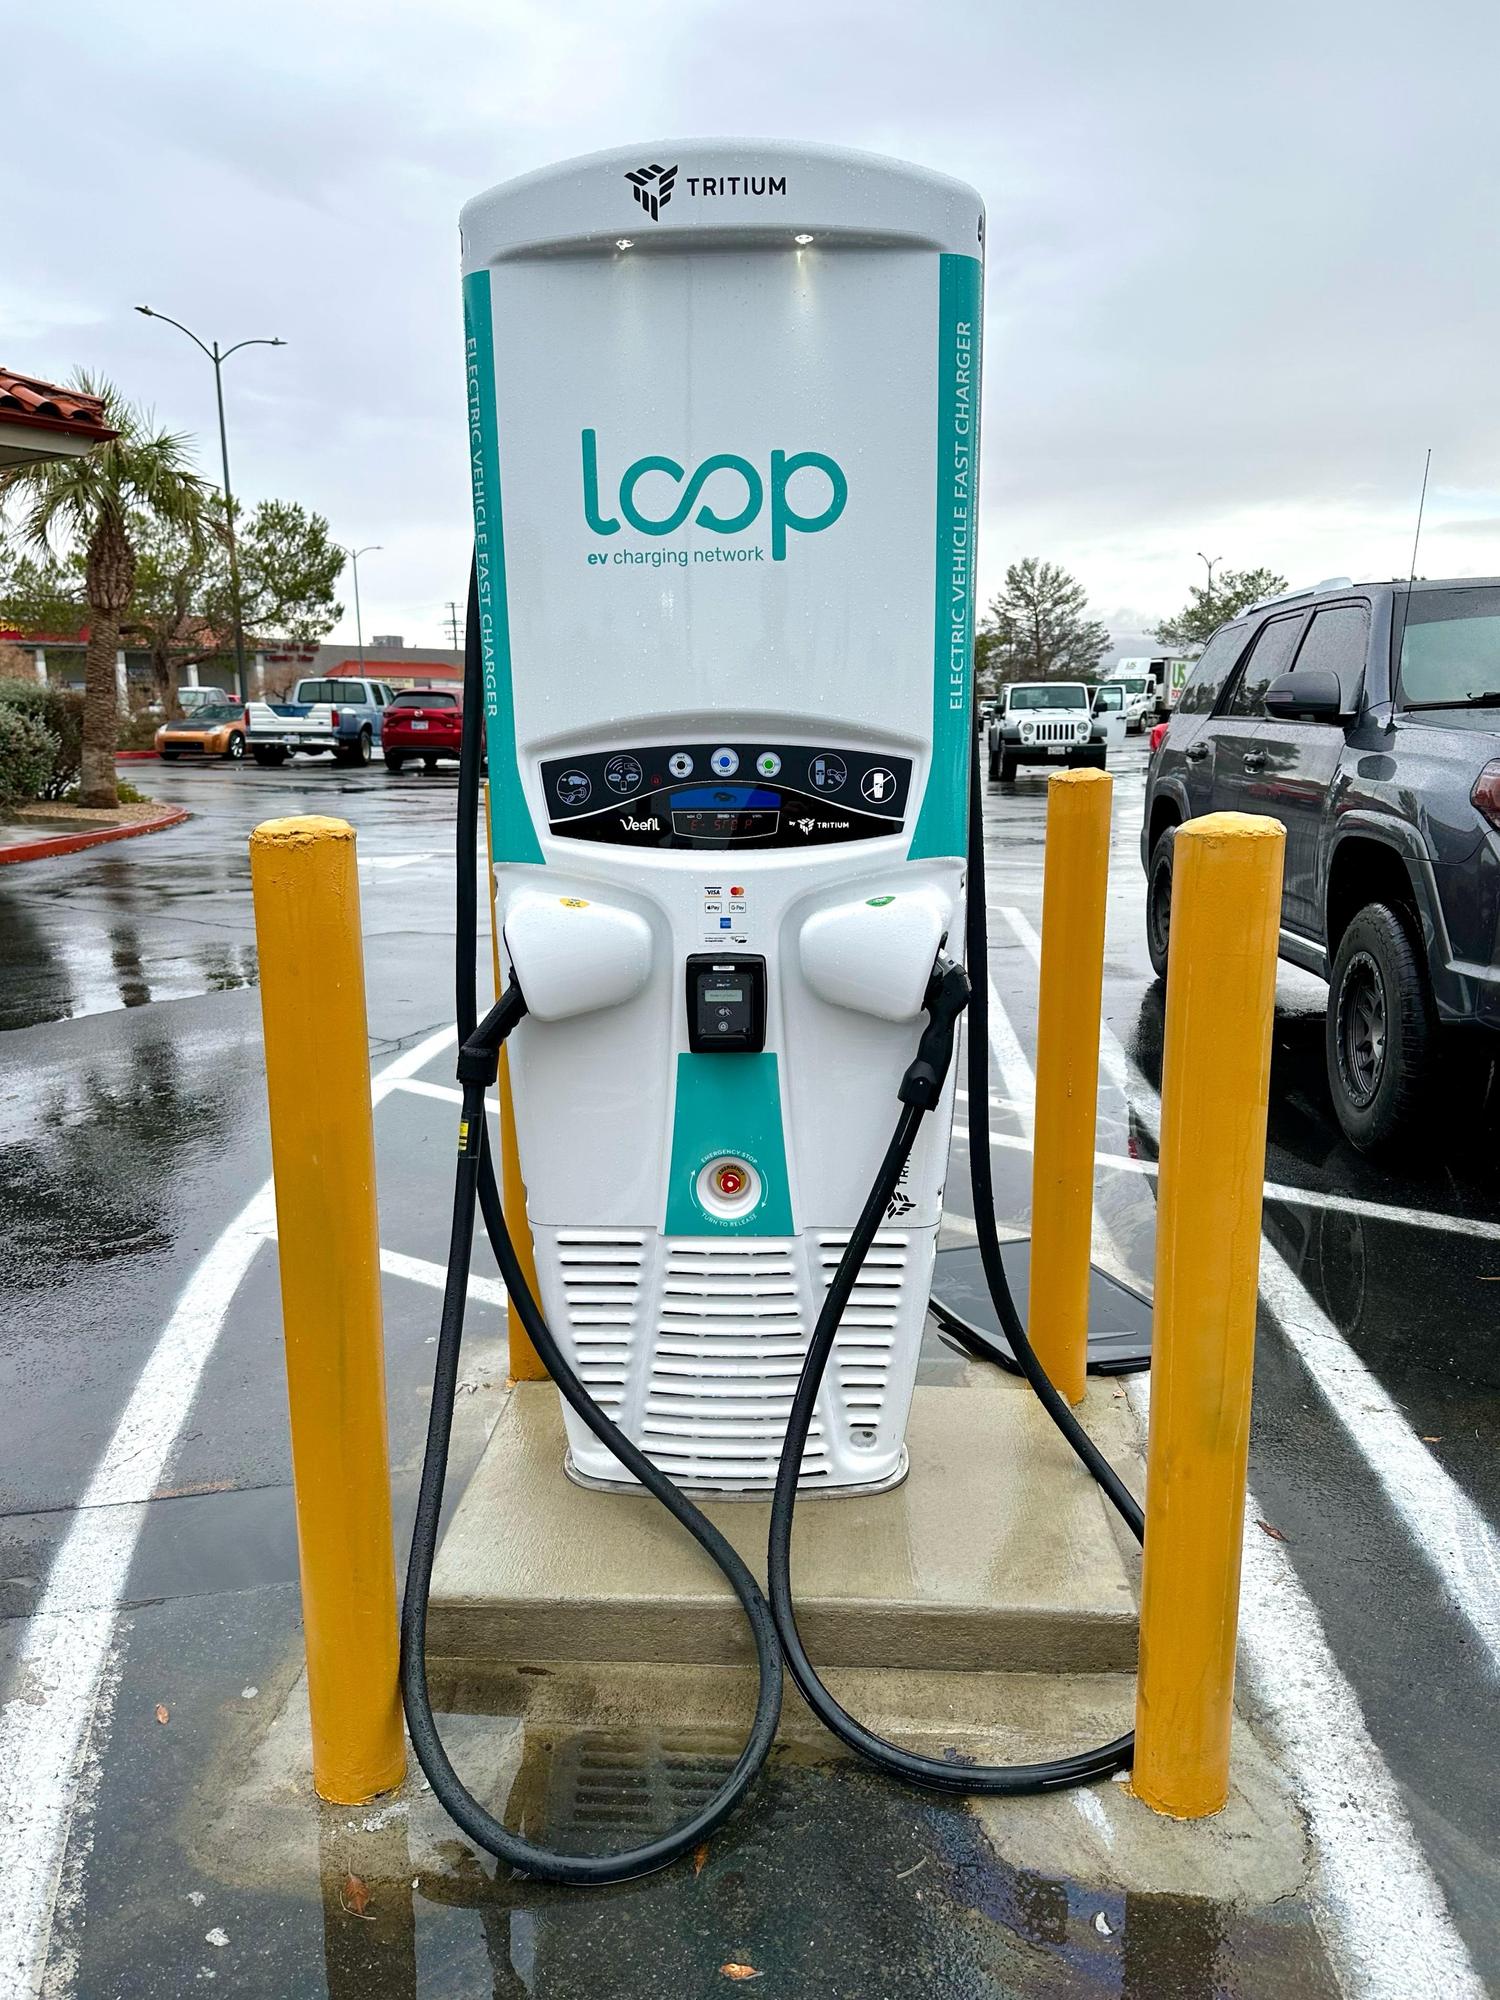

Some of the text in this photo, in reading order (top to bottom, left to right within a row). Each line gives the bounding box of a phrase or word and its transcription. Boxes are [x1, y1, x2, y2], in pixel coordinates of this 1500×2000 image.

[687, 177, 787, 196] TRITIUM
[581, 428, 848, 561] loop
[950, 321, 971, 710] ELECTRIC VEHICLE FAST CHARGER
[466, 337, 498, 717] ELECTRIC VEHICLE FAST CHARGER
[587, 546, 764, 567] ev charging network
[620, 816, 661, 831] Veefil
[817, 821, 850, 829] TRITIUM
[701, 1149, 758, 1164] EMERGENCY STOP
[702, 1212, 718, 1225] TURN
[729, 1213, 758, 1227] RELEASE
